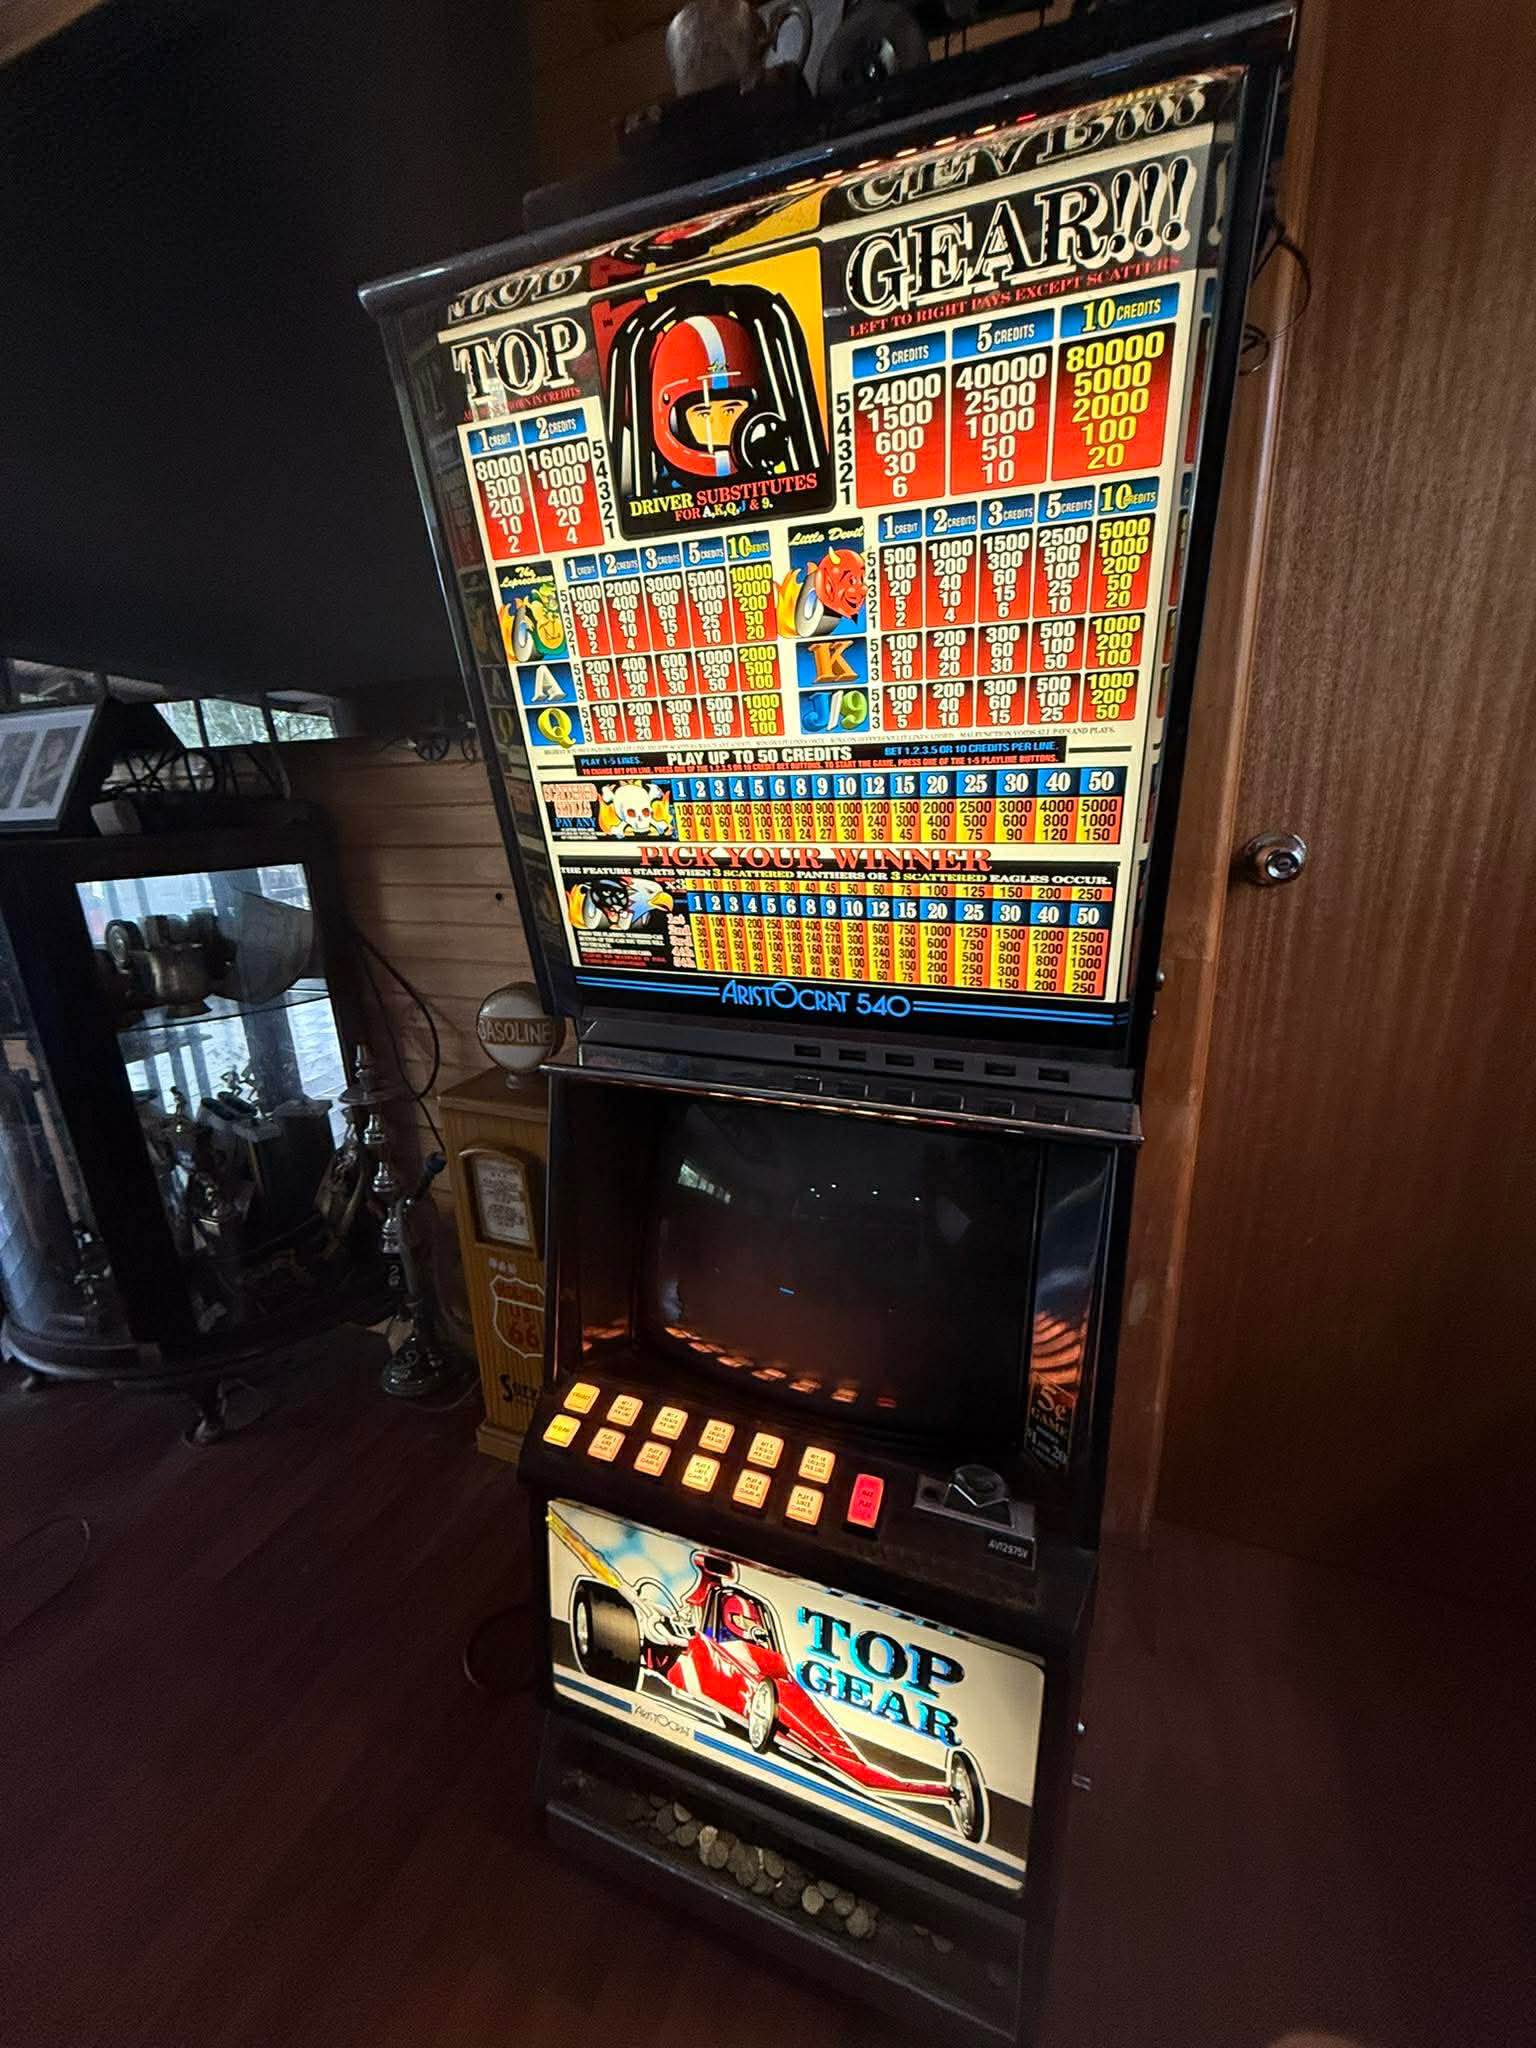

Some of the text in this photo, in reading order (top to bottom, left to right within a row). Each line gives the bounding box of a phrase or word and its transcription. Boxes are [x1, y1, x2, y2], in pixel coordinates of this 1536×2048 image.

[845, 156, 1198, 316] GEAR!!!
[849, 255, 1181, 338] LEFT TO RIGHT PAYS EXCEPT SCATTERS
[1083, 298, 1161, 332] 10 CREDITS
[977, 322, 1035, 352] 5 CREDITS
[451, 317, 586, 400] TOP
[875, 345, 929, 373] 3 CREDITS
[1065, 331, 1165, 373] 80000
[956, 352, 1047, 391] 40000
[1074, 361, 1152, 397] 5000
[858, 373, 941, 411] 24000
[964, 381, 1036, 416] 2500
[867, 400, 933, 433] 1500
[1072, 388, 1149, 423] 2000
[536, 417, 576, 441] 2 CREDITS
[965, 407, 1035, 440] 1000
[1081, 416, 1136, 446] 100
[479, 430, 490, 451] 1
[875, 426, 924, 455] 600
[981, 435, 1015, 461] 50
[476, 455, 522, 481] 8000
[528, 442, 589, 471] 16000
[1087, 443, 1125, 470] 20
[538, 463, 586, 489] 1000
[892, 476, 907, 498] 6
[630, 473, 817, 516] DRIVER SUBSTITUTES
[1046, 492, 1092, 519] 5 CREDITS
[1101, 483, 1132, 512] 10
[490, 497, 524, 518] 200
[674, 507, 701, 521] FOR
[749, 499, 760, 510] &
[762, 497, 773, 509] 9.
[988, 501, 1033, 526] 3 CREDITS
[883, 514, 919, 540] 1 CREDIT
[933, 508, 948, 533] 2
[1099, 517, 1150, 540] 5000
[508, 535, 519, 553] 2
[567, 527, 577, 543] 4
[789, 524, 864, 546] Little Devil
[984, 532, 1030, 554] 1500
[1039, 525, 1088, 548] 2500
[1099, 536, 1148, 558] 1000
[689, 542, 699, 564] 5
[728, 536, 750, 559] 10
[884, 546, 916, 566] 500
[646, 575, 681, 593] 3000
[688, 569, 724, 587] 5000
[730, 563, 772, 582] 10000
[569, 585, 601, 601] 1000
[606, 580, 640, 597] 2000
[1092, 615, 1140, 634] 1000
[739, 646, 776, 662] 2000
[808, 640, 858, 682] K
[531, 664, 567, 701] A
[1088, 672, 1134, 689] 1000
[537, 707, 576, 748] Q
[667, 752, 705, 766] PLAY
[708, 751, 730, 765] UP
[732, 750, 754, 764] TO
[757, 749, 778, 763] 50
[782, 746, 852, 762] CREDITS
[884, 746, 903, 756] BET
[955, 745, 966, 754] 10
[968, 743, 1010, 753] CREDITS
[1011, 743, 1033, 751] PER
[581, 758, 600, 766] PLAY
[898, 758, 921, 766] PRESS
[677, 771, 1114, 798] 1 2 3 4 5 6 8 9 10 12 15 20 25 30 40 50
[1040, 800, 1117, 813] 4000 5000
[1043, 814, 1116, 826] 800 1000
[1085, 829, 1110, 840] 150
[639, 846, 992, 871] PICK YOUR WINNER
[561, 867, 1112, 885] THE FEATURE STARTS WHEN 3 SCATTERED PANTHERS OR 3 SCATTERED EAGLES OCCUR.
[1078, 889, 1102, 900] 250
[927, 903, 1100, 925] 20 25 30 40 50
[1072, 932, 1104, 943] 2500
[1073, 970, 1096, 981] 500
[721, 979, 911, 1018] ARISTOCRAT 540
[477, 1019, 553, 1044] GASOLINE
[509, 1323, 539, 1347] 66
[796, 1606, 965, 1699] TOP
[795, 1660, 962, 1747] GEAR
